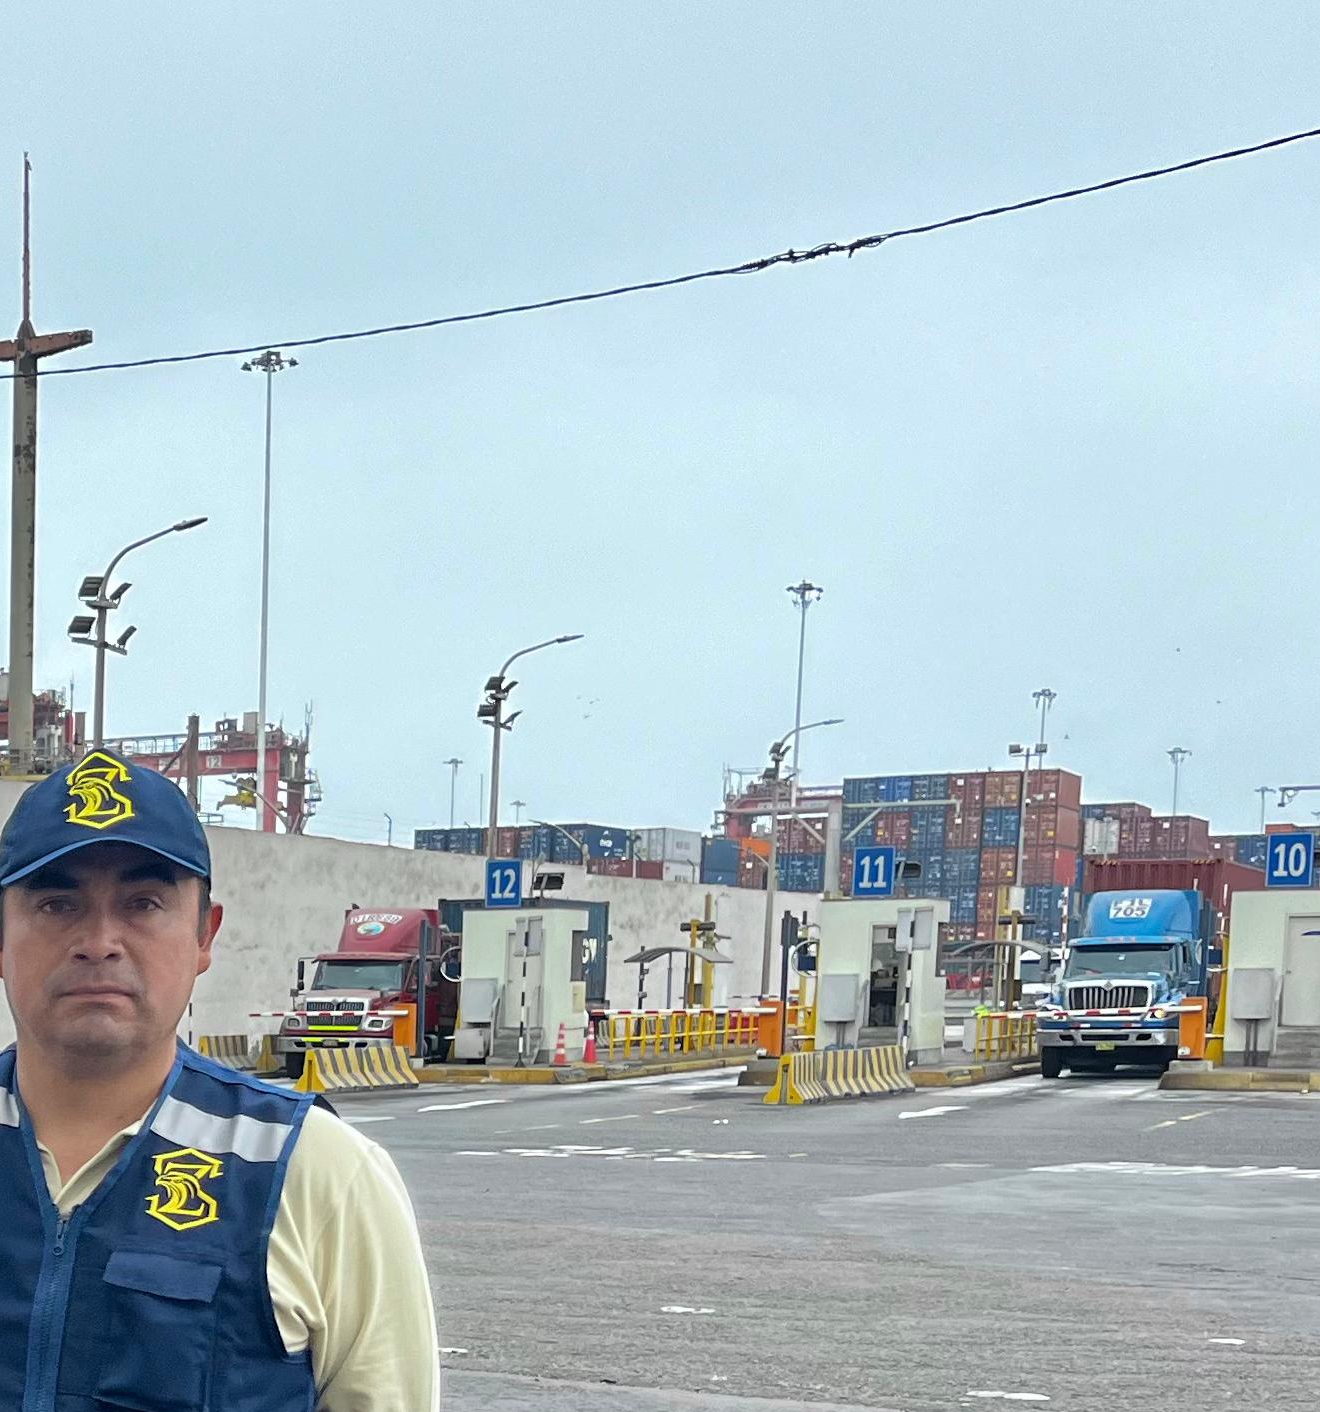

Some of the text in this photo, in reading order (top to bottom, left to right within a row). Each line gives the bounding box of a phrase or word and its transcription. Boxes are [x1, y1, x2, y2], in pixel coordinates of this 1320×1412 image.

[859, 855, 887, 889] 11
[1273, 842, 1307, 878] 10
[491, 868, 516, 899] 12
[1113, 906, 1146, 917] 705
